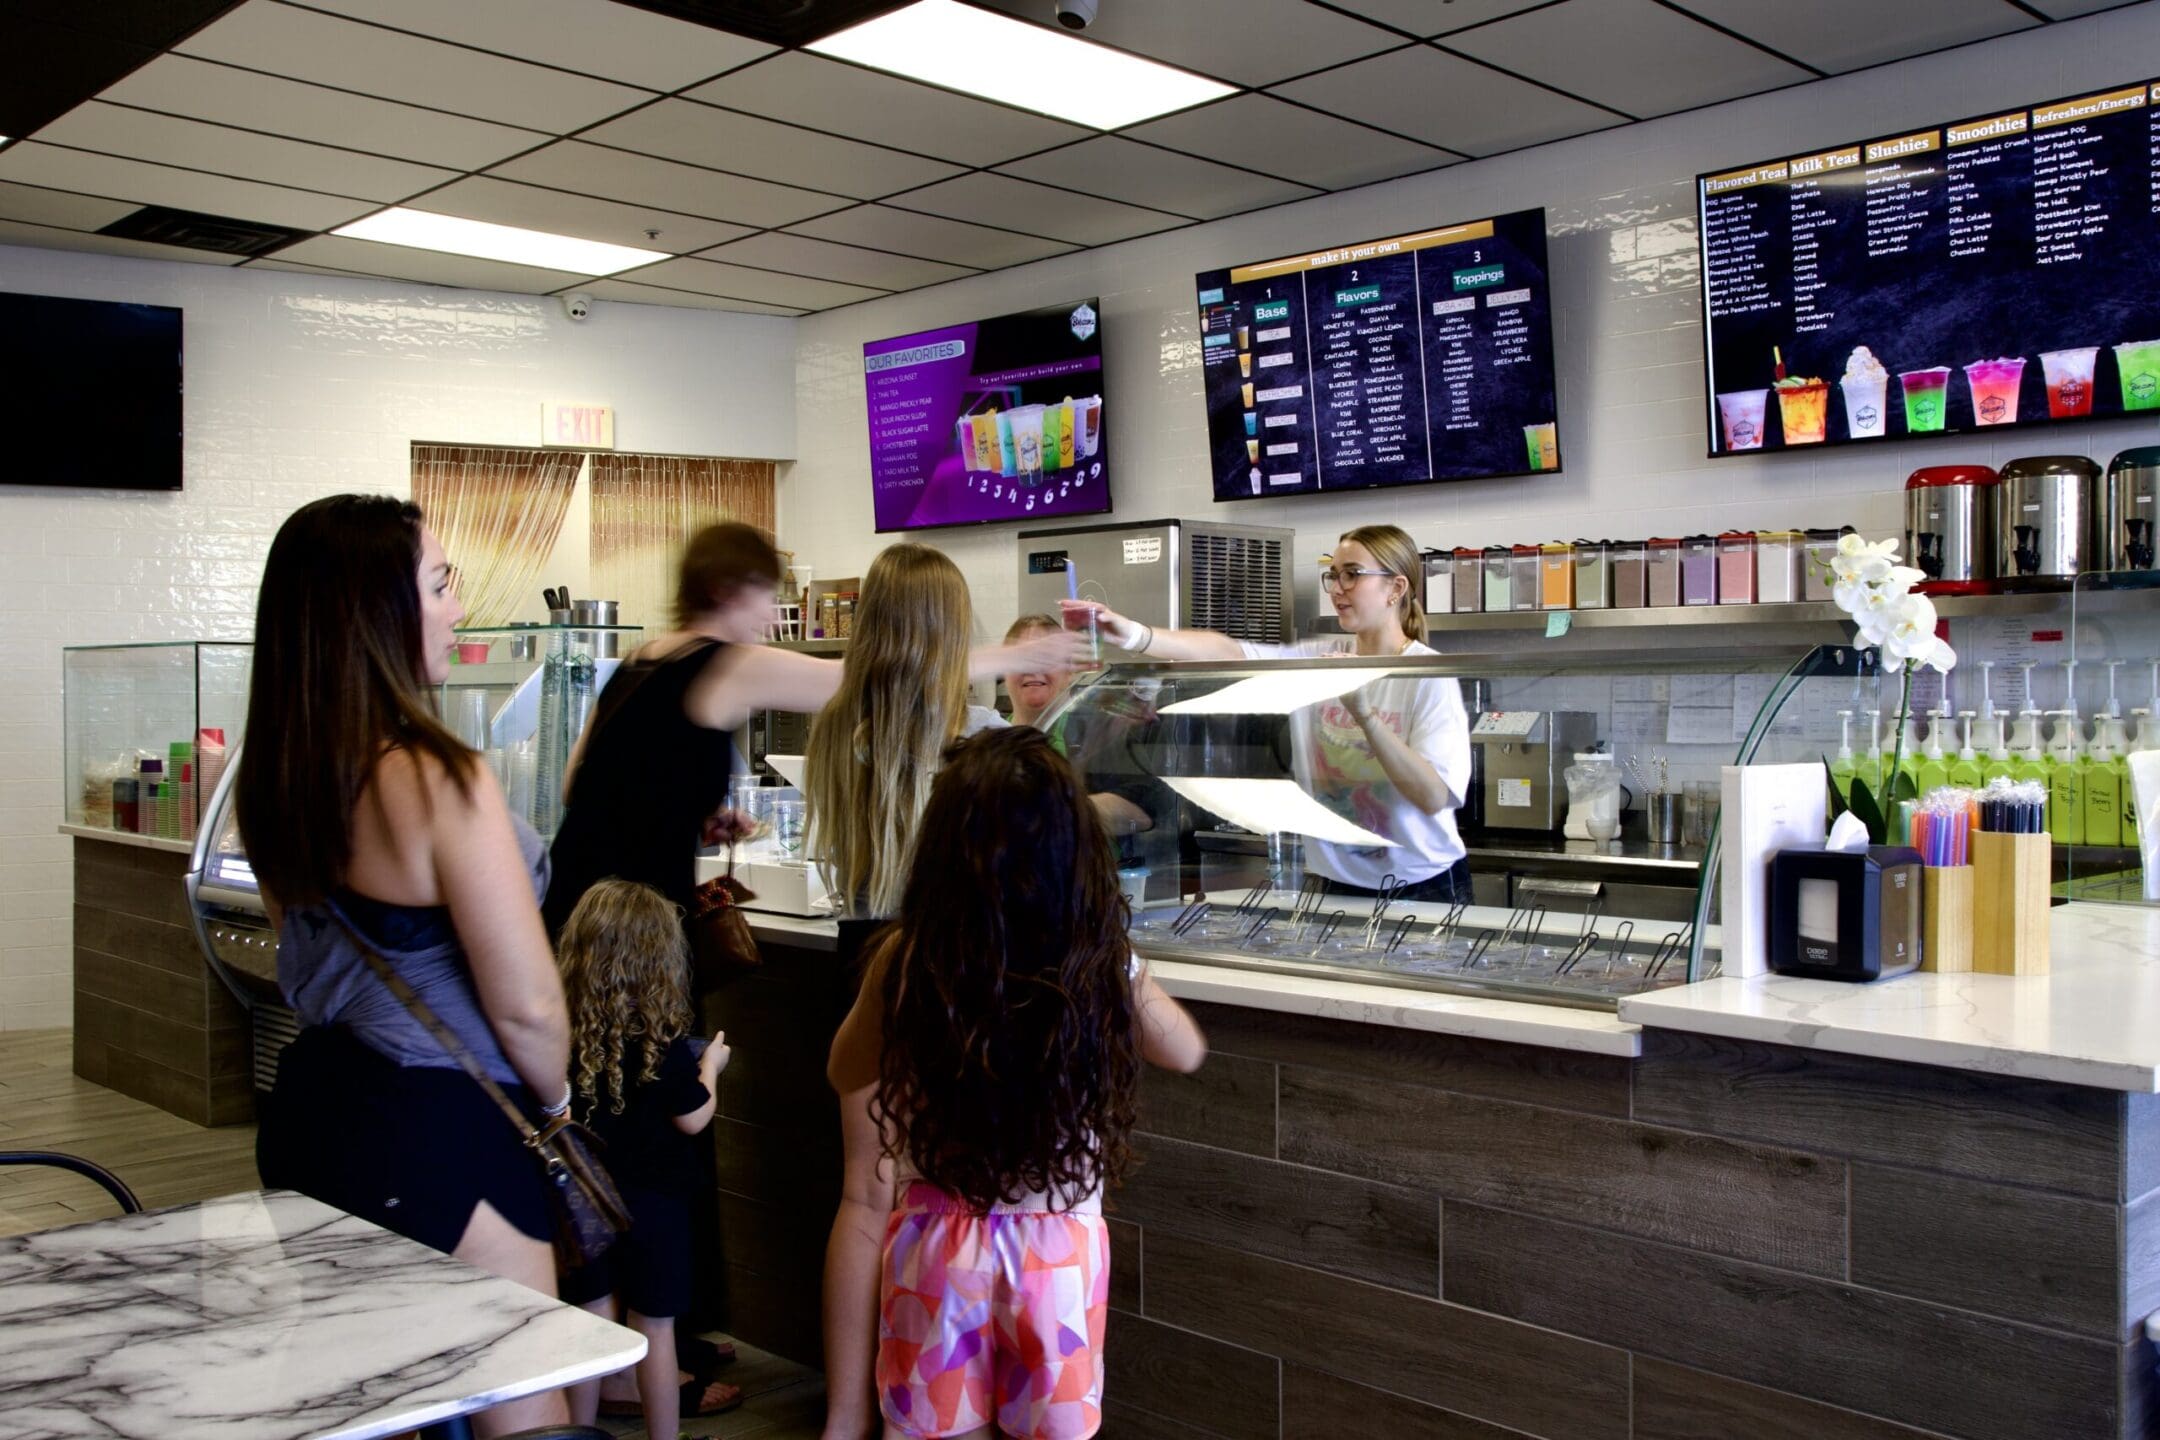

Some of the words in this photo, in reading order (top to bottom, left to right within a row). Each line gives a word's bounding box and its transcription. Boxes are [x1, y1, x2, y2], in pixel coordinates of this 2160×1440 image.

[2033, 94, 2145, 124] Refreshers/Energy
[1947, 118, 2027, 143] Smoothies
[1869, 138, 1929, 159] Slushies
[1791, 157, 1823, 175] Milk
[1827, 154, 1858, 168] Teas
[1706, 172, 1756, 192] Flavored
[1759, 168, 1788, 180] Teas
[1312, 252, 1339, 265] make
[1341, 250, 1349, 259] it
[1351, 246, 1375, 261] your
[1378, 241, 1400, 253] own
[1474, 251, 1481, 262] 3
[1352, 270, 1358, 281] 2
[1454, 267, 1504, 286] Toppings
[1266, 288, 1271, 299] 1
[1337, 289, 1379, 303] Flavors
[1256, 306, 1287, 319] Base
[869, 355, 892, 370] OUR
[895, 343, 954, 364] FAVORITES
[557, 408, 604, 443] EXIT
